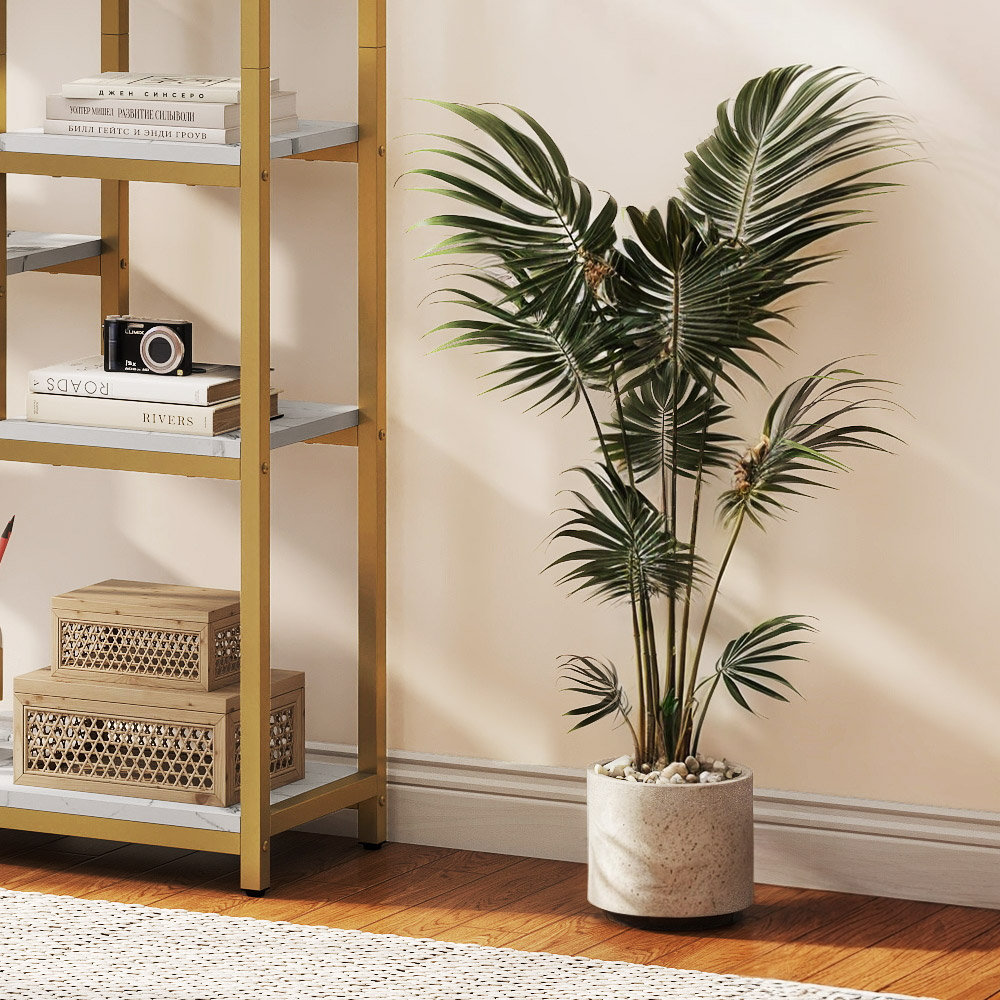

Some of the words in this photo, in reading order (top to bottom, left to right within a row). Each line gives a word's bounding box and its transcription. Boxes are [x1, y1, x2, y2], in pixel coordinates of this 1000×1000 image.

[98, 89, 134, 98] ДЖЕН
[144, 91, 205, 99] СИНСЕРО
[117, 107, 155, 120] РАЗВИТИЕ
[155, 110, 176, 121] СИЛЫ
[176, 111, 195, 122] ВОЛИ
[68, 125, 95, 134] БИЛЛ
[98, 126, 130, 136] ГЕЙТС
[133, 128, 141, 136] И
[144, 129, 173, 138] ЭНДИ
[175, 131, 207, 140] ГРОУВ
[47, 377, 109, 396] ROADS
[142, 412, 194, 427] RIVERS
